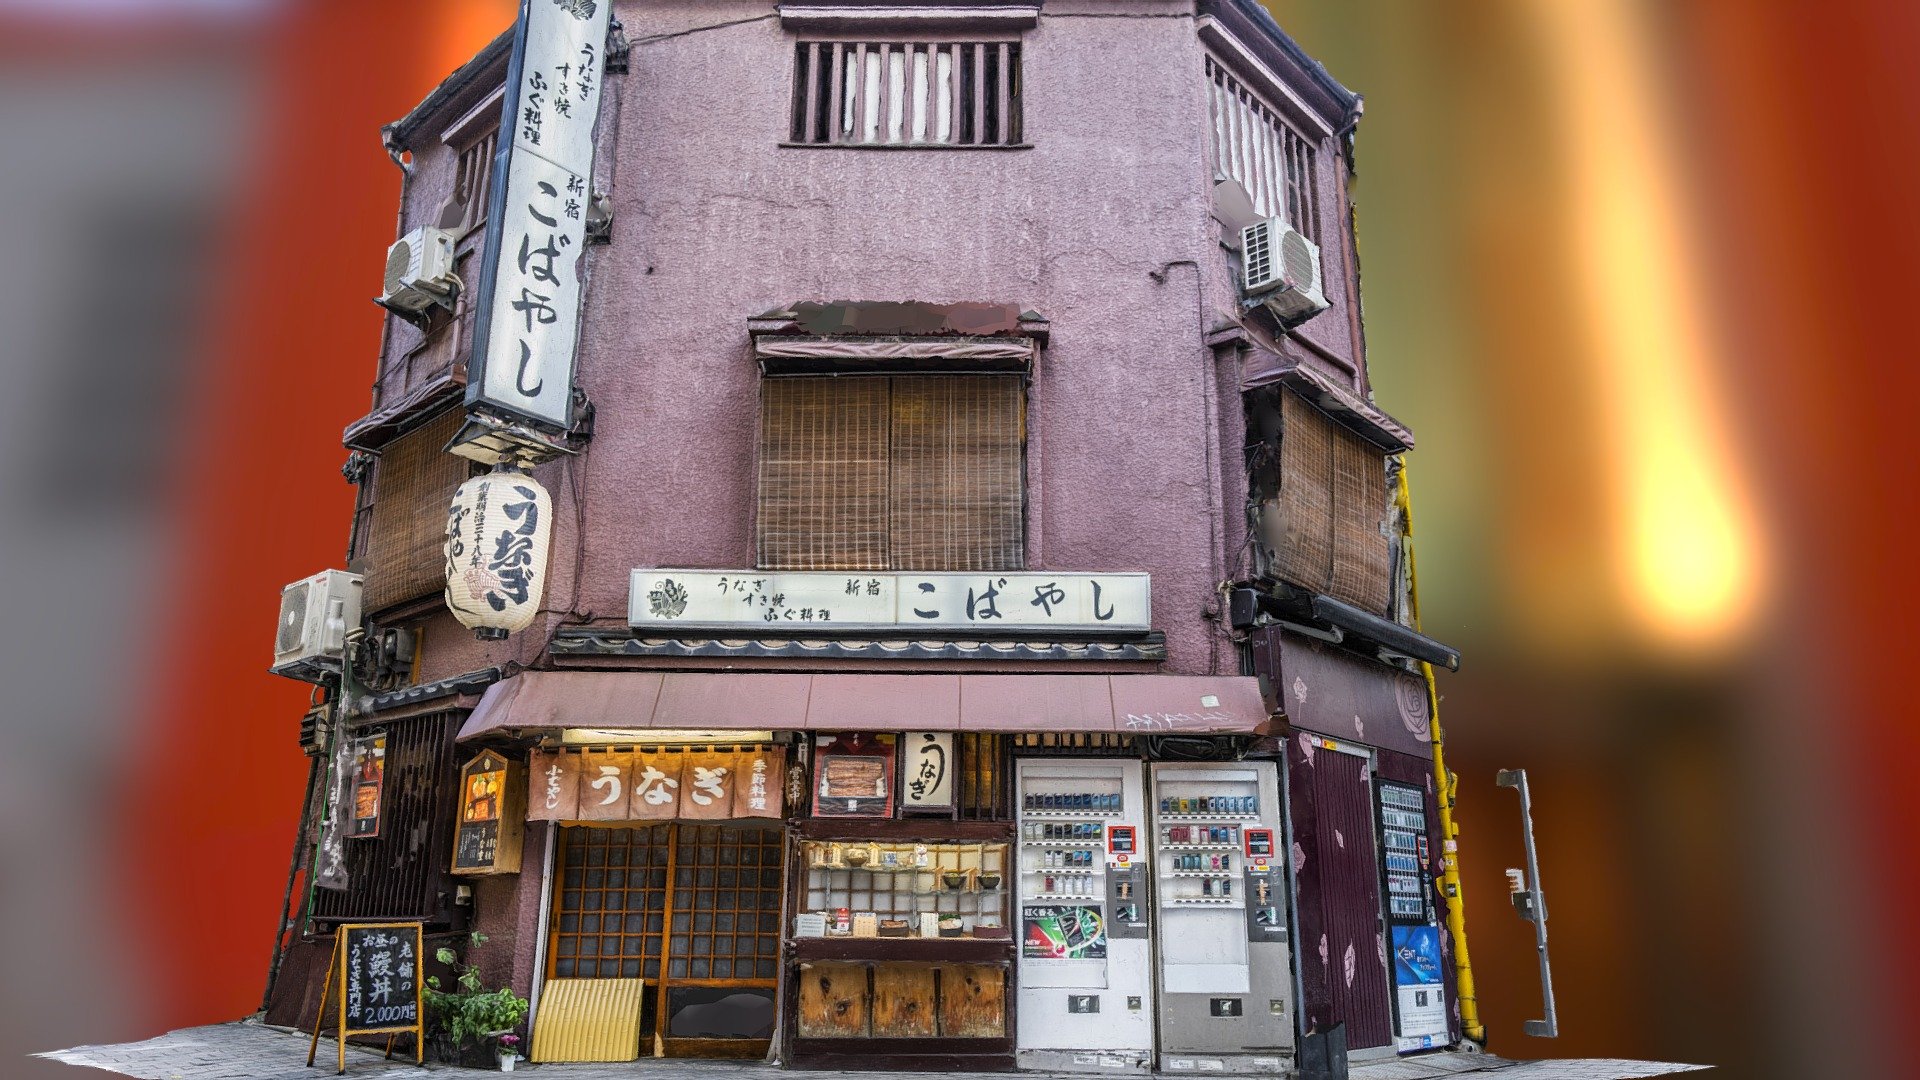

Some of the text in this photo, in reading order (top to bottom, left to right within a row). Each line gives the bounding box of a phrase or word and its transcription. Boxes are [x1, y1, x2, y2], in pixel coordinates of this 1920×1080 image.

[555, 63, 571, 119] すき焼
[577, 43, 595, 101] うなぎ
[523, 71, 548, 145] ふぐ料理
[565, 175, 584, 220] 新宿
[512, 181, 571, 397] こばやし
[486, 486, 538, 611] うなぎ
[717, 578, 767, 595] うなぎ
[742, 593, 785, 607] すき焼
[845, 579, 881, 596] 新宿
[913, 577, 1114, 620] こばやし
[764, 608, 831, 623] ふぐ料理
[591, 765, 727, 806] うなぎ
[751, 759, 767, 809] 季節料理
[908, 733, 945, 800] うなぎ
[362, 934, 398, 948] お昼の
[397, 941, 415, 991] 老舗の
[348, 944, 362, 1018] うなぎ専門店
[368, 951, 394, 1004] 鰻丼
